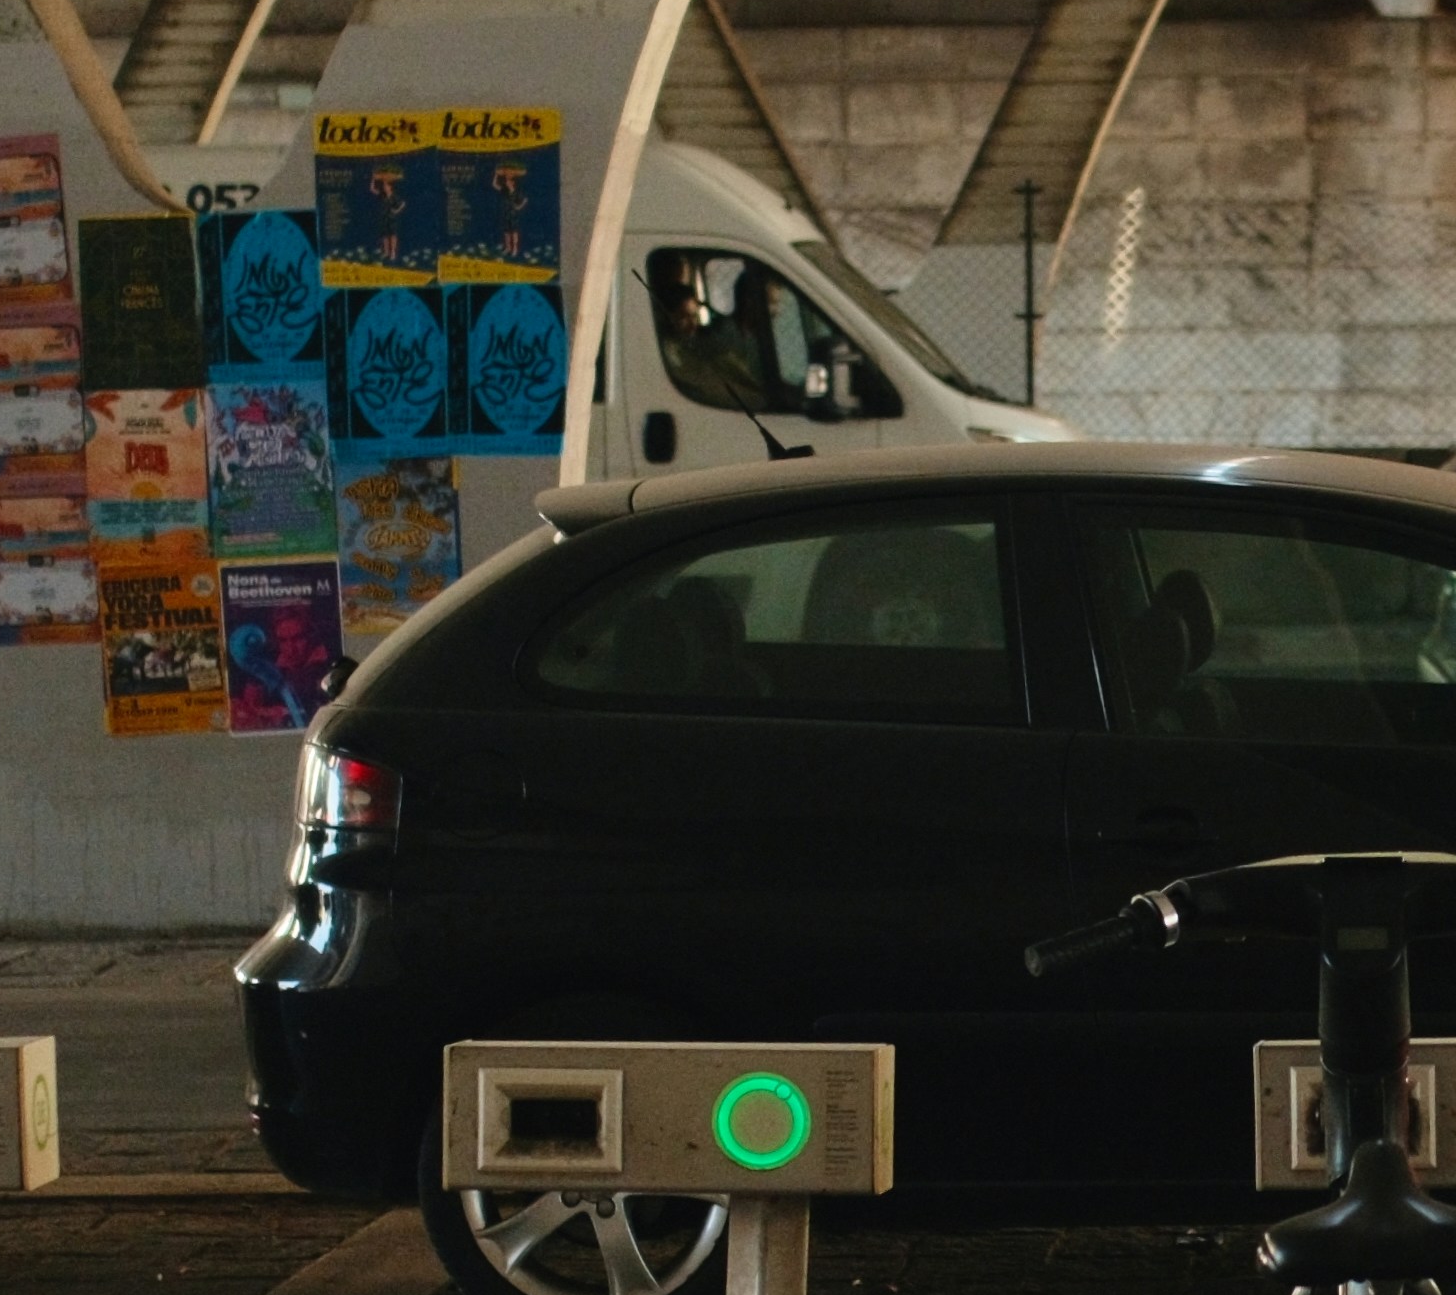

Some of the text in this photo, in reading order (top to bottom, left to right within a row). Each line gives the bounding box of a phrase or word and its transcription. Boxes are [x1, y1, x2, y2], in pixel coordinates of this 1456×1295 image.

[320, 116, 396, 143] todos
[442, 111, 520, 138] todos
[102, 575, 181, 595] ERICEIRA
[227, 574, 269, 587] Nona
[228, 585, 312, 599] Beethoven
[104, 593, 163, 613] YOGA
[104, 607, 217, 630] FESTIVAL
